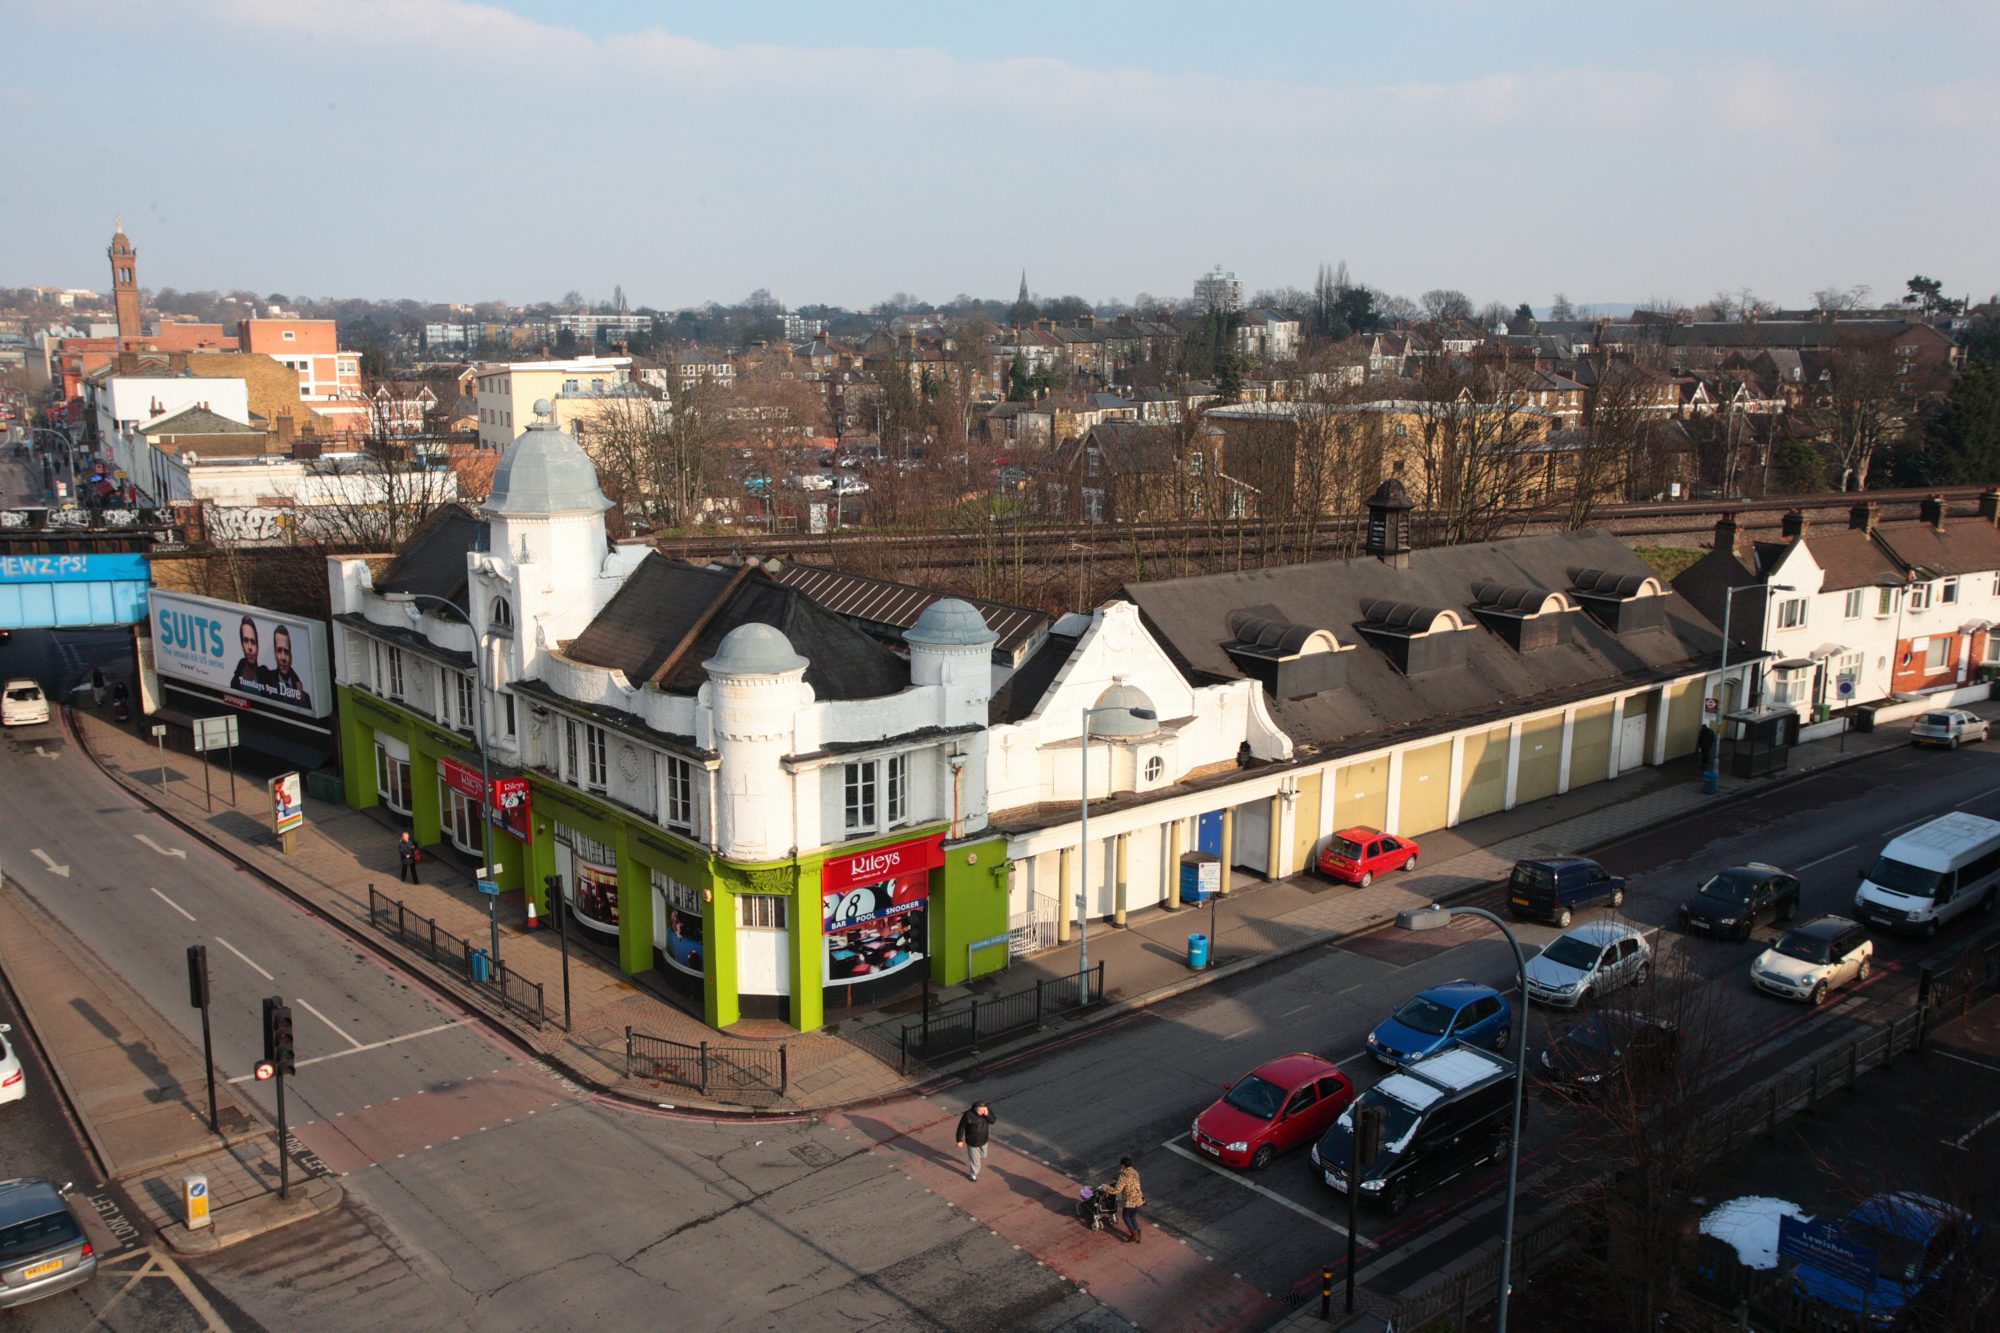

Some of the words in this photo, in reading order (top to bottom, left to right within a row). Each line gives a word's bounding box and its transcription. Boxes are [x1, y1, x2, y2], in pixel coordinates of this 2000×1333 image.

[159, 608, 225, 658] SUITS
[190, 653, 198, 662] hit
[199, 656, 207, 665] US
[207, 659, 225, 670] series
[238, 676, 265, 692] Tuesdays
[265, 683, 279, 695] 9pm
[279, 682, 301, 700] Dave
[504, 782, 525, 791] Rileys
[851, 852, 900, 875] Rileys
[831, 920, 847, 930] BAR
[856, 913, 876, 923] POOL
[885, 900, 919, 915] SNOOKER
[846, 894, 861, 917] 8
[300, 1155, 333, 1177] LEFT
[88, 1193, 120, 1217] LEFT
[105, 1214, 140, 1242] LOOK
